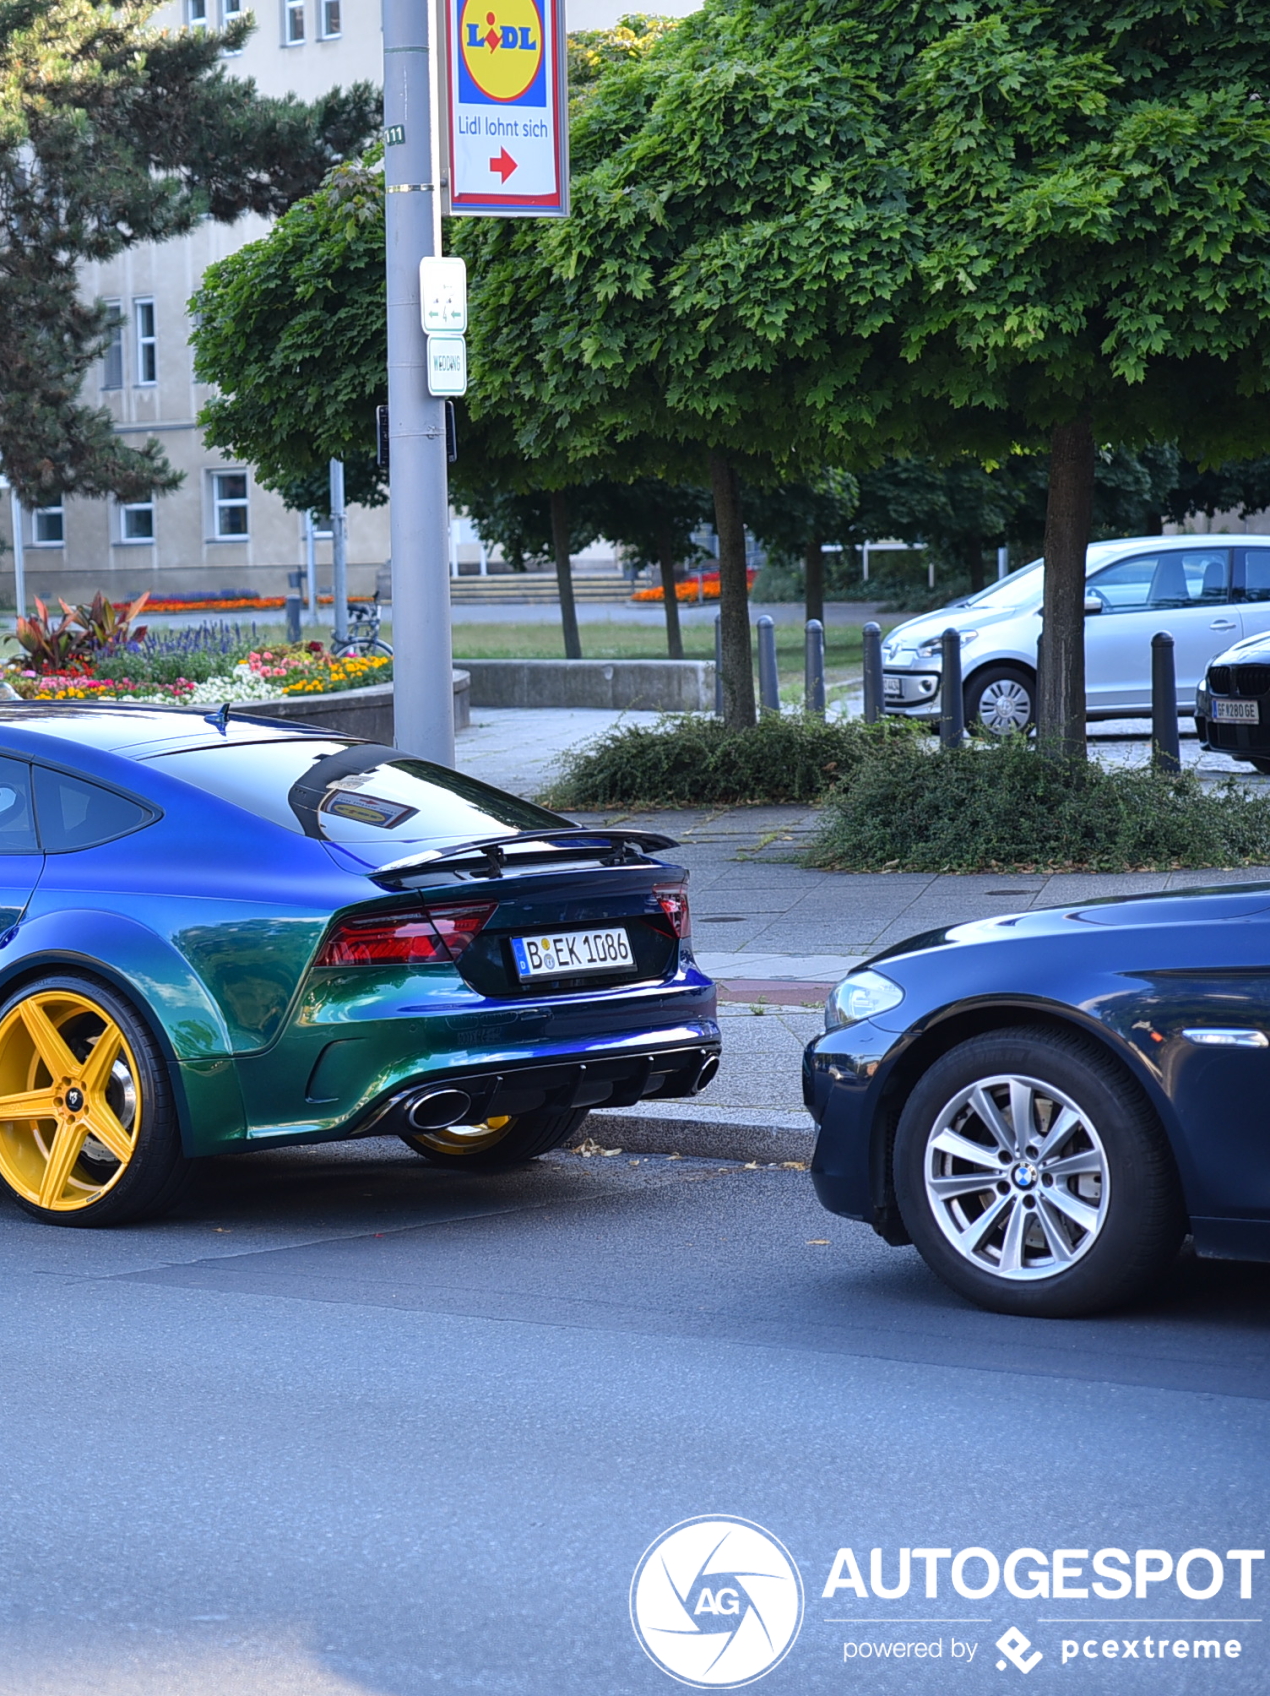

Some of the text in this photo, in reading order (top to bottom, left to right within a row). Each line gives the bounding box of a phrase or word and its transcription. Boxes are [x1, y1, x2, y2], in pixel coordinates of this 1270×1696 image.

[458, 116, 548, 138] Lidl lohnt sich
[433, 356, 461, 371] WEDDING
[527, 933, 628, 969] B EK 1086
[520, 961, 527, 970] D
